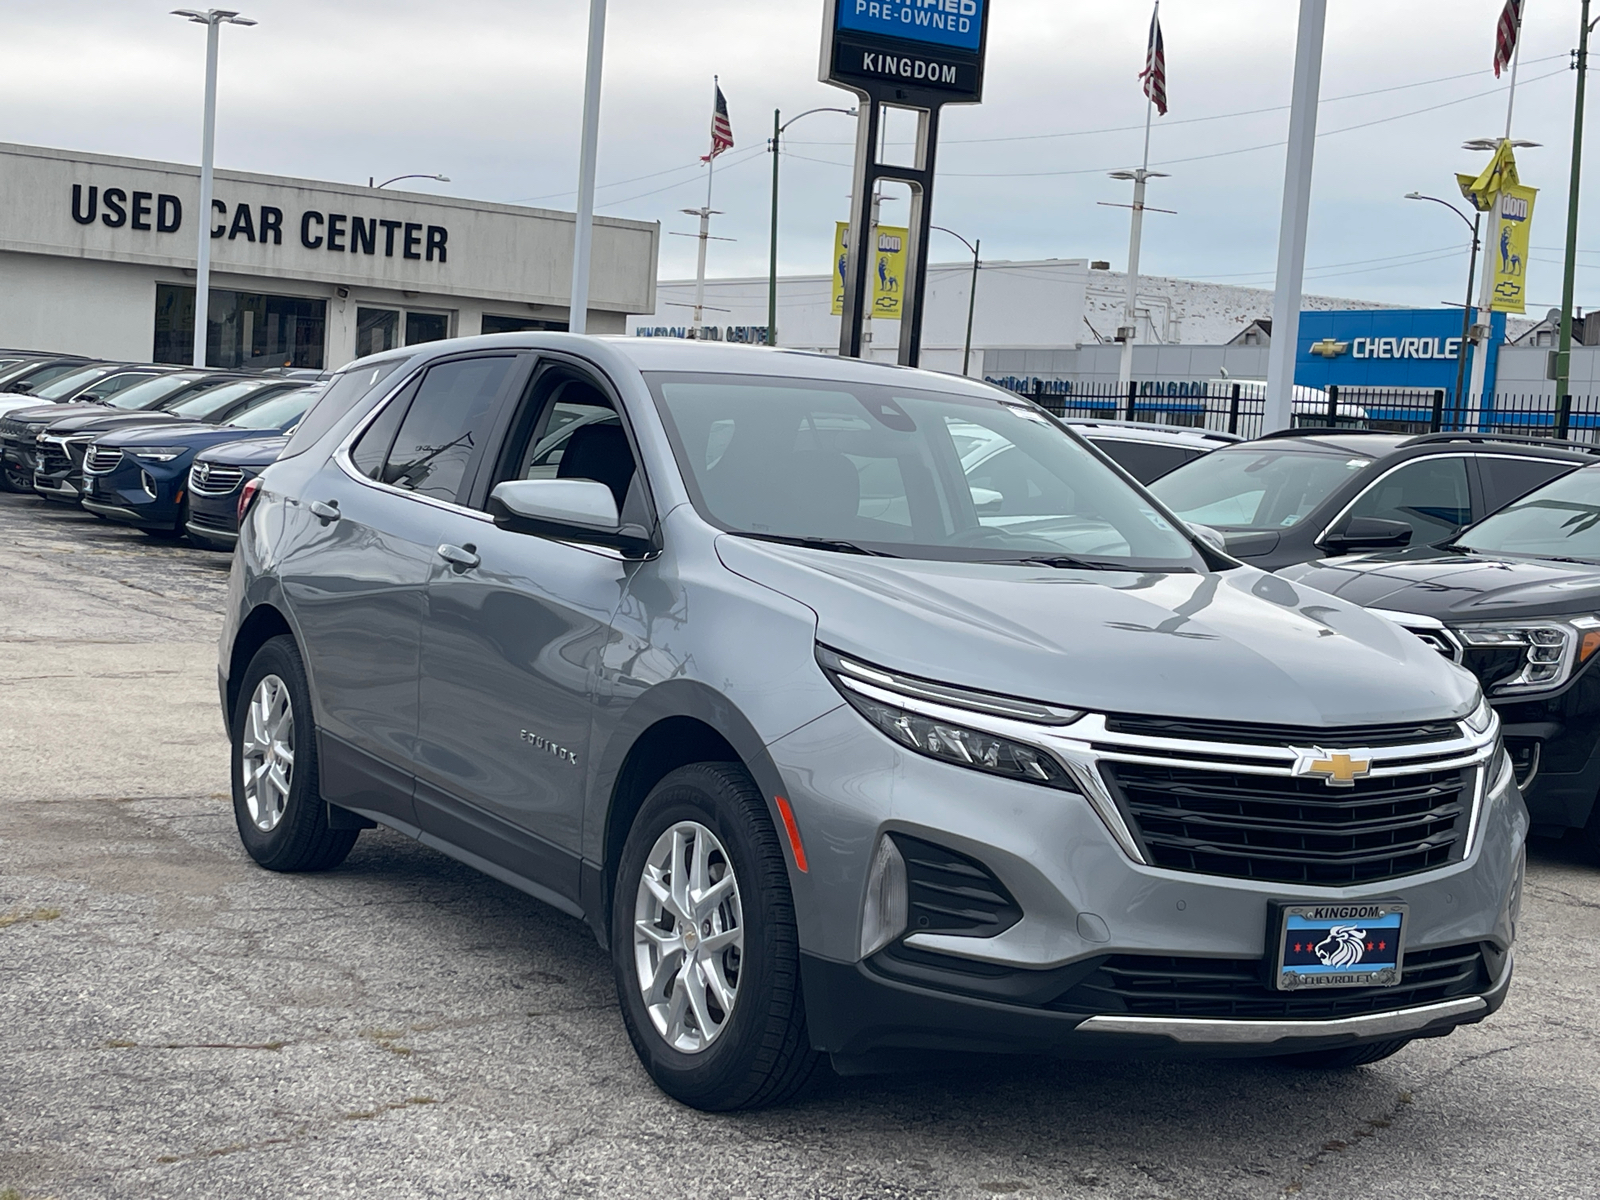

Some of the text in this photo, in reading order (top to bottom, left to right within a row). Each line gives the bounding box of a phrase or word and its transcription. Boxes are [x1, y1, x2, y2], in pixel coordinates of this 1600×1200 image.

[855, 0, 970, 33] PRE-OWNED
[863, 52, 957, 84] KINGDOM
[1501, 192, 1528, 219] dom
[71, 184, 449, 264] USED CAR CENTER
[878, 232, 902, 251] dom
[726, 326, 776, 345] CENTE
[1352, 336, 1471, 360] CHEVROLE
[520, 728, 577, 765] EQUINOX
[1314, 906, 1379, 919] KINGDOM
[1304, 974, 1371, 985] CHEVROLET
